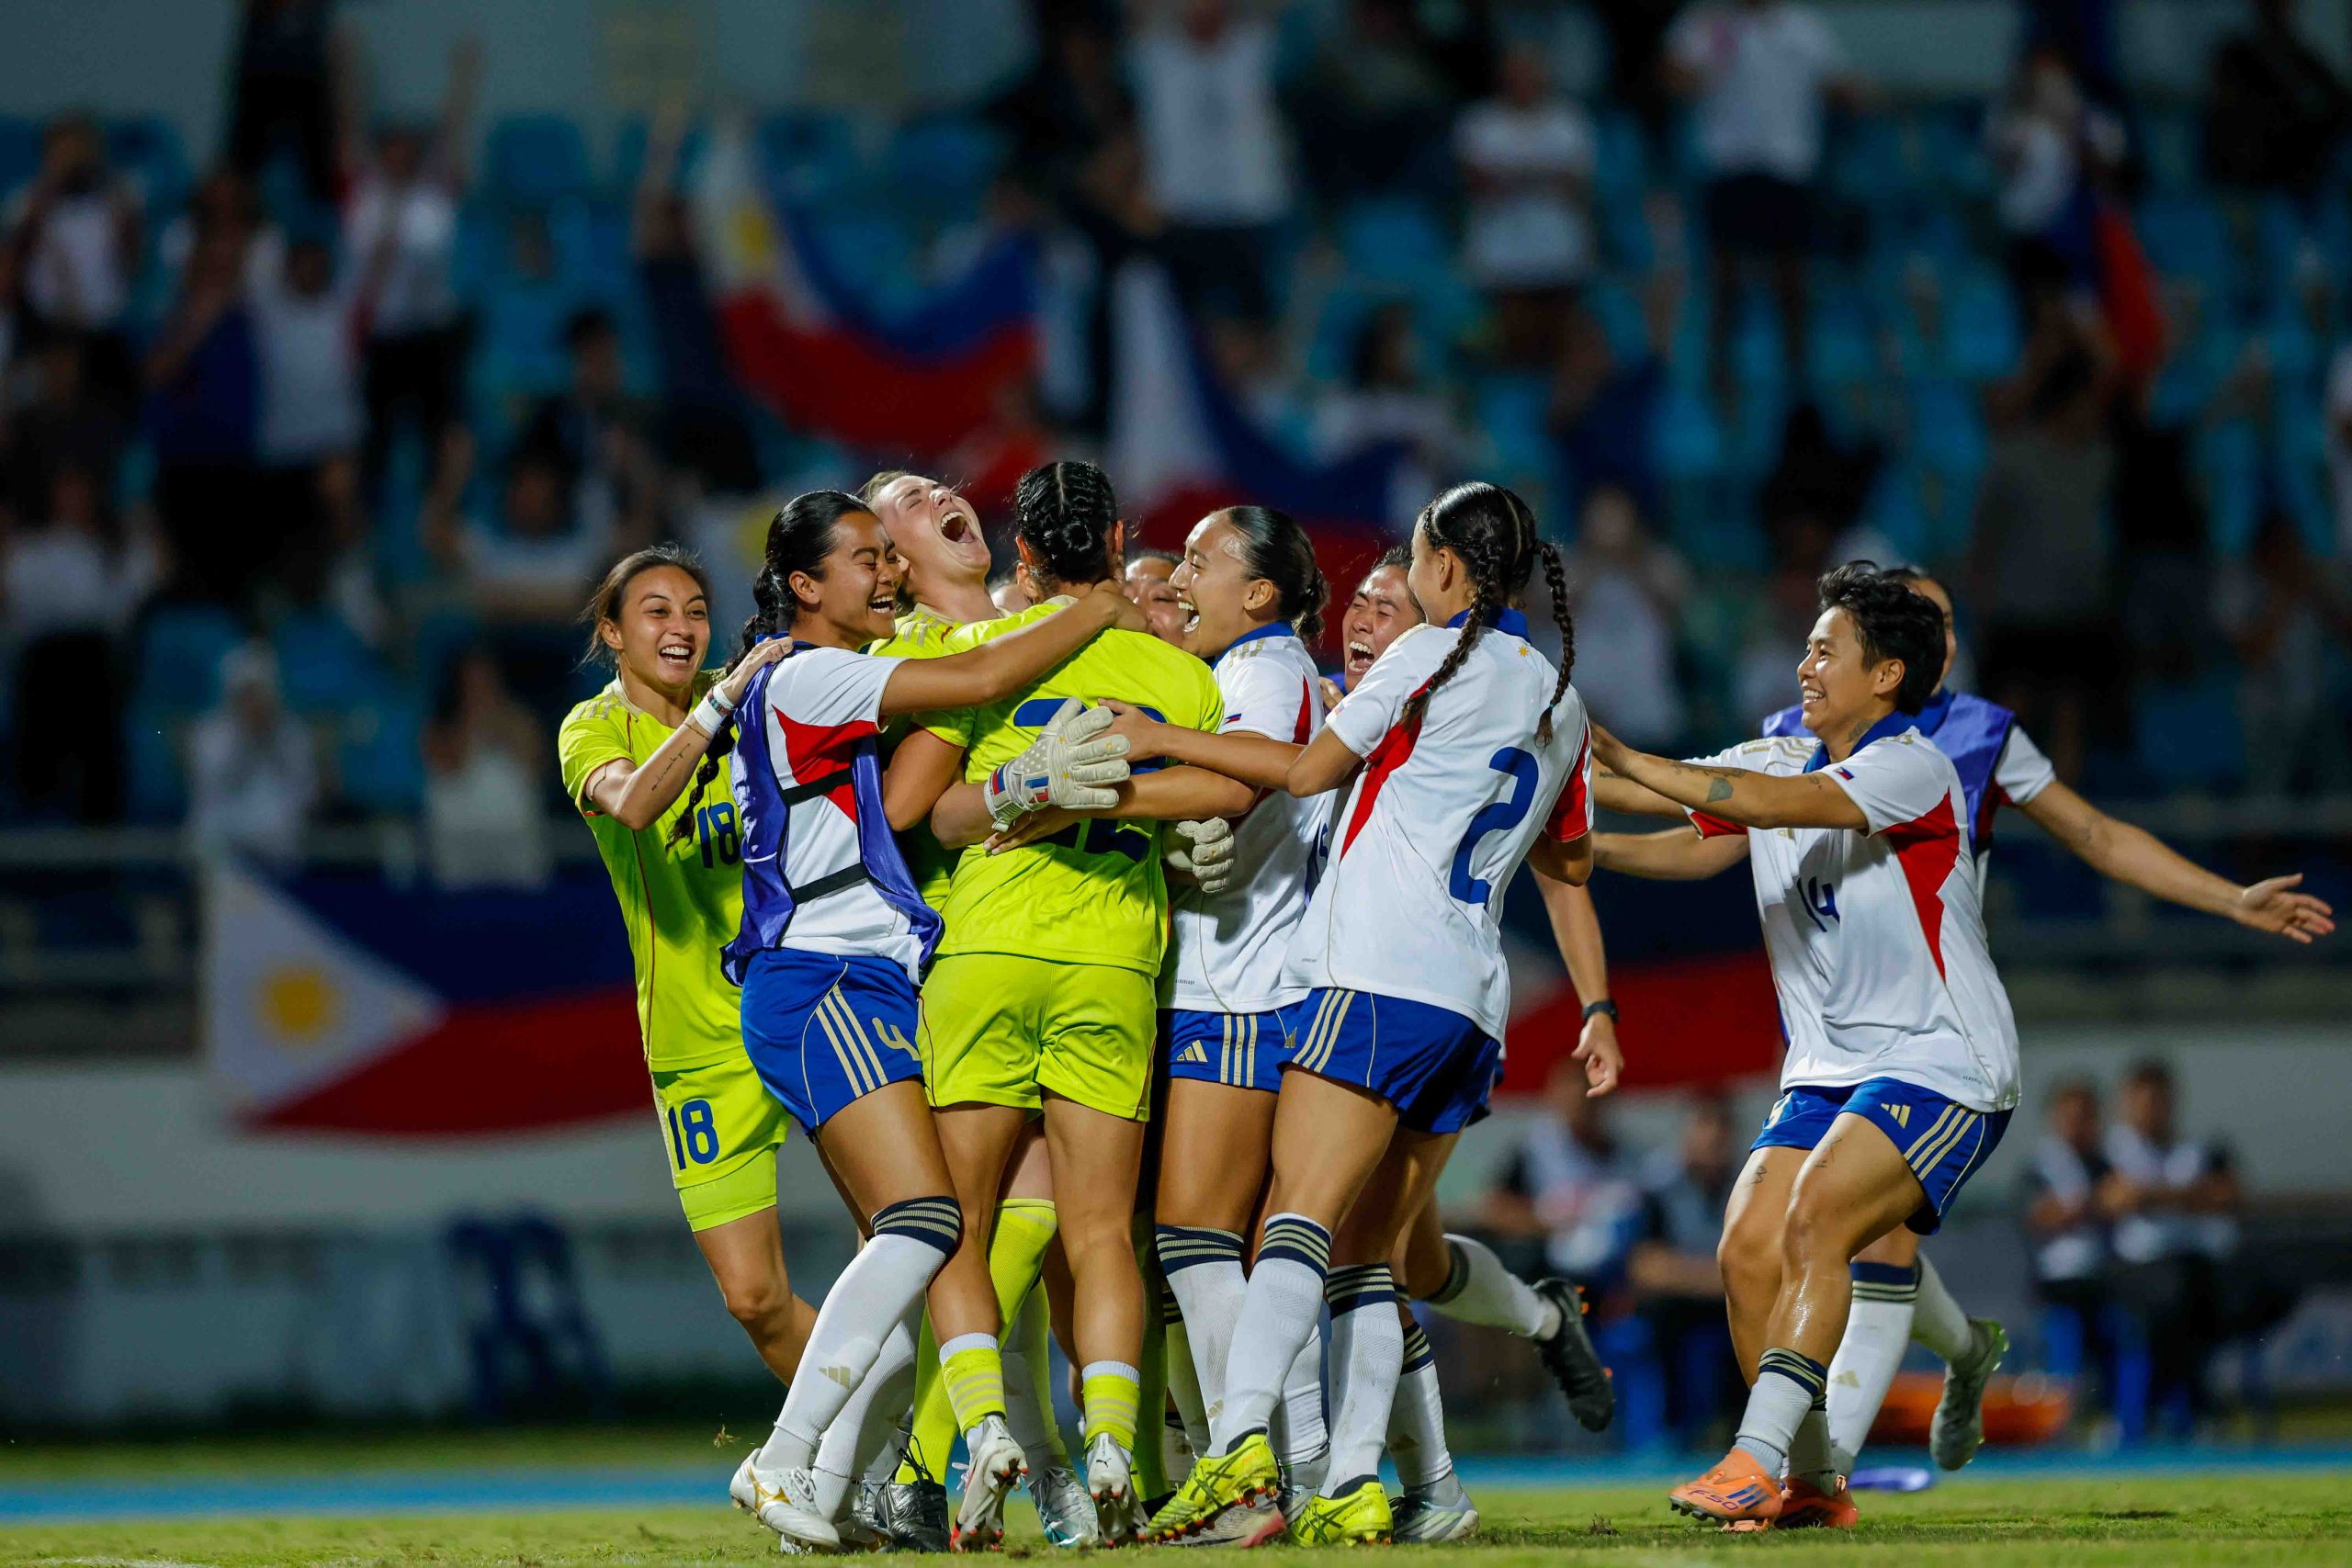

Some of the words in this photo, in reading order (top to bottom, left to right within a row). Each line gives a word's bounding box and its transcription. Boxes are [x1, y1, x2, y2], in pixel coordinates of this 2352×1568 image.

[697, 801, 741, 869] 18
[1449, 746, 1539, 911] 2
[1796, 875, 1840, 932] 14
[872, 1017, 922, 1062] 4
[668, 1099, 719, 1171] 18
